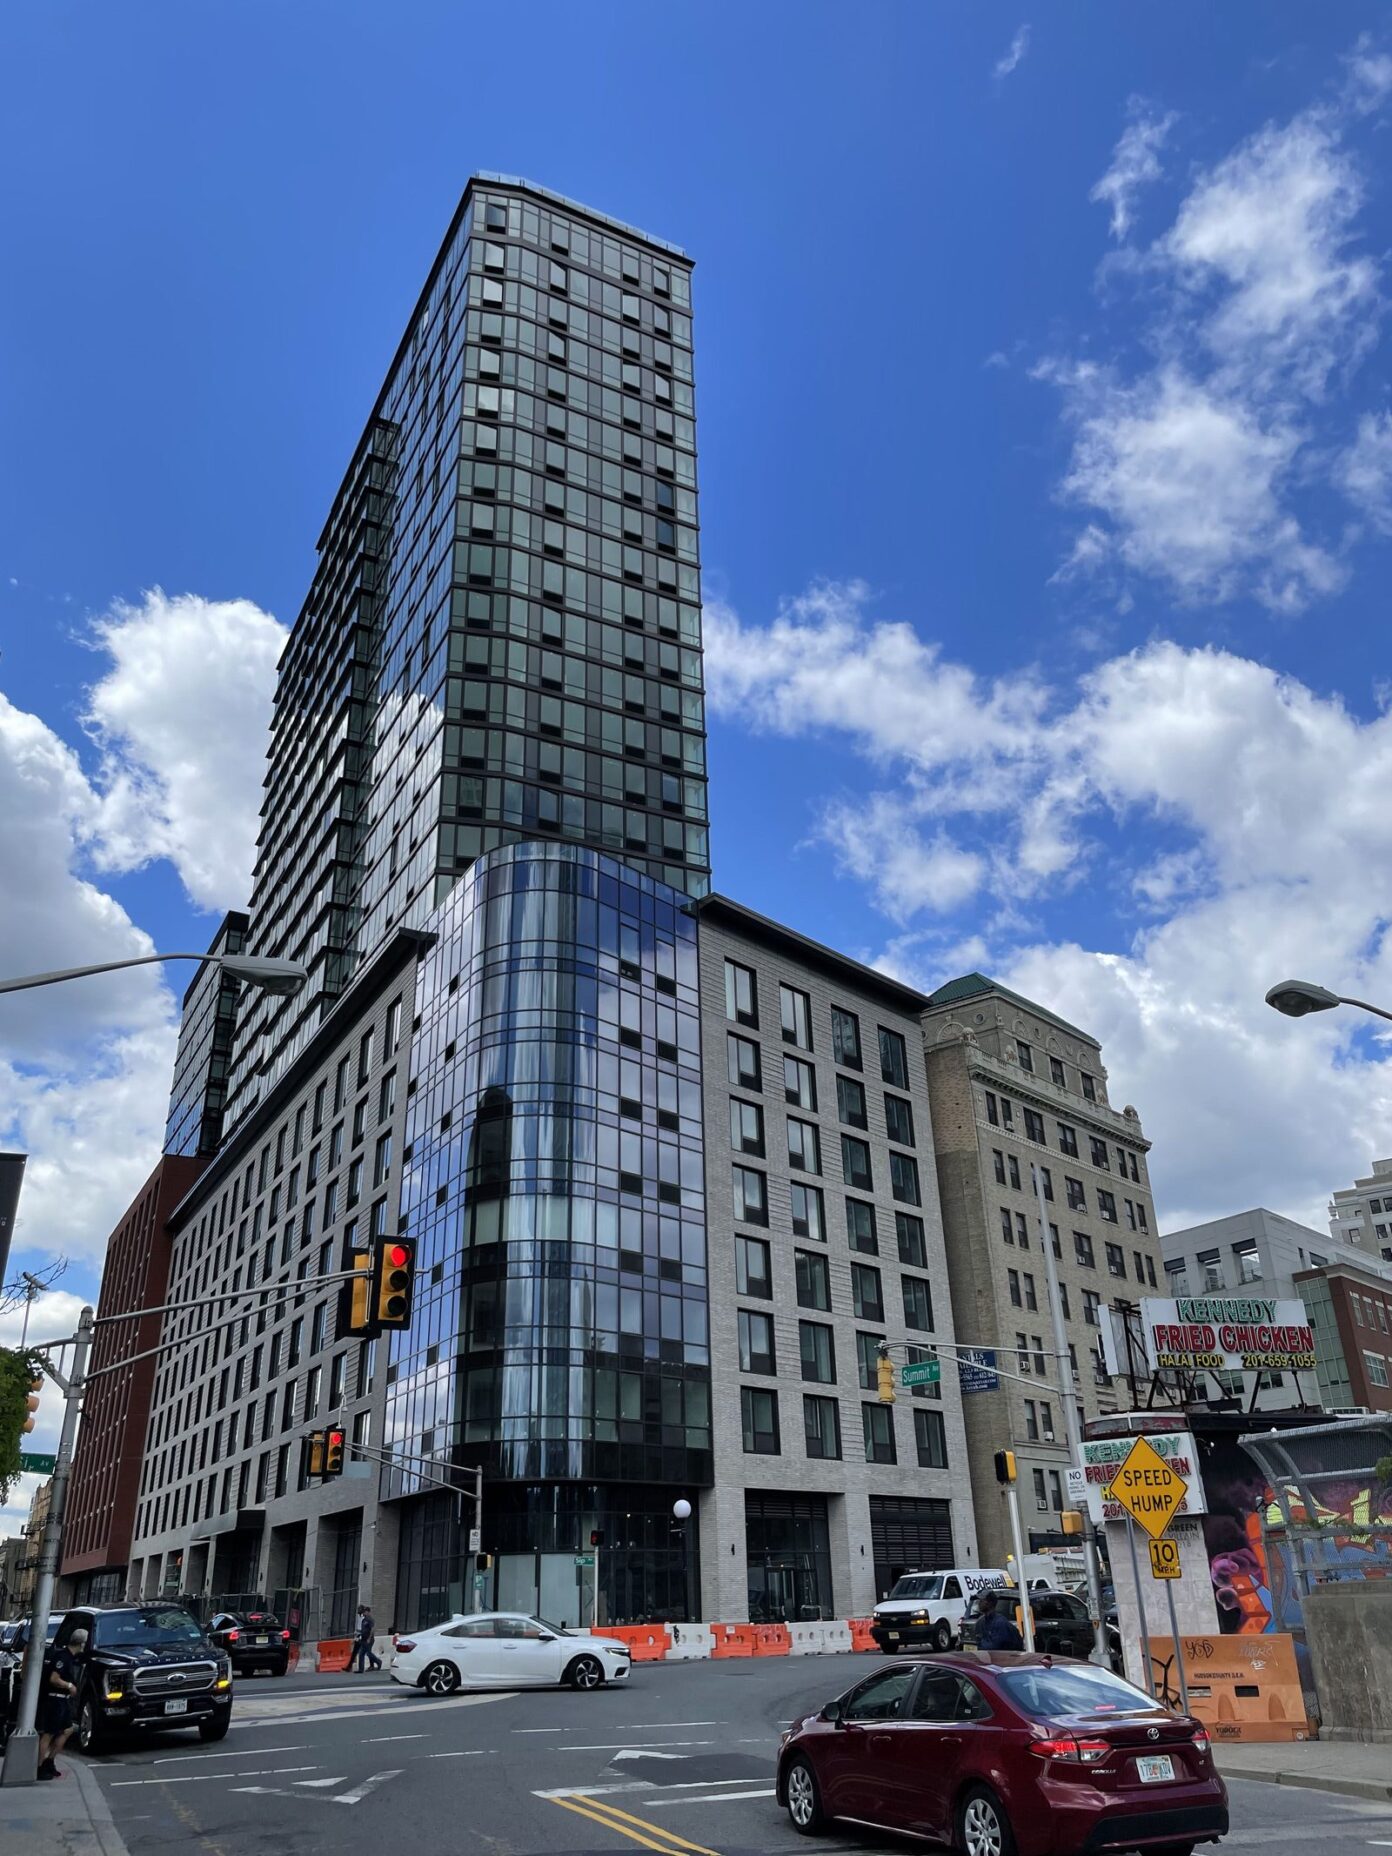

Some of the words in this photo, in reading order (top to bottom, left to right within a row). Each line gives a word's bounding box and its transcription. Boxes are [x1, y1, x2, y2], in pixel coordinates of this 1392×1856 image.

[1177, 1299, 1277, 1322] KENNEDY
[1153, 1325, 1216, 1351] FRIED
[1220, 1325, 1314, 1352] CHICKEN
[1196, 1354, 1225, 1368] FOOD
[1242, 1355, 1317, 1368] 201-659-1055
[903, 1367, 930, 1383] Summit
[1083, 1438, 1180, 1463] KENDY
[1069, 1471, 1081, 1480] NO
[1123, 1469, 1172, 1487] SPEED
[1131, 1495, 1173, 1513] HUMP
[1153, 1544, 1174, 1563] 10
[964, 1574, 1008, 1591] Bodewell
